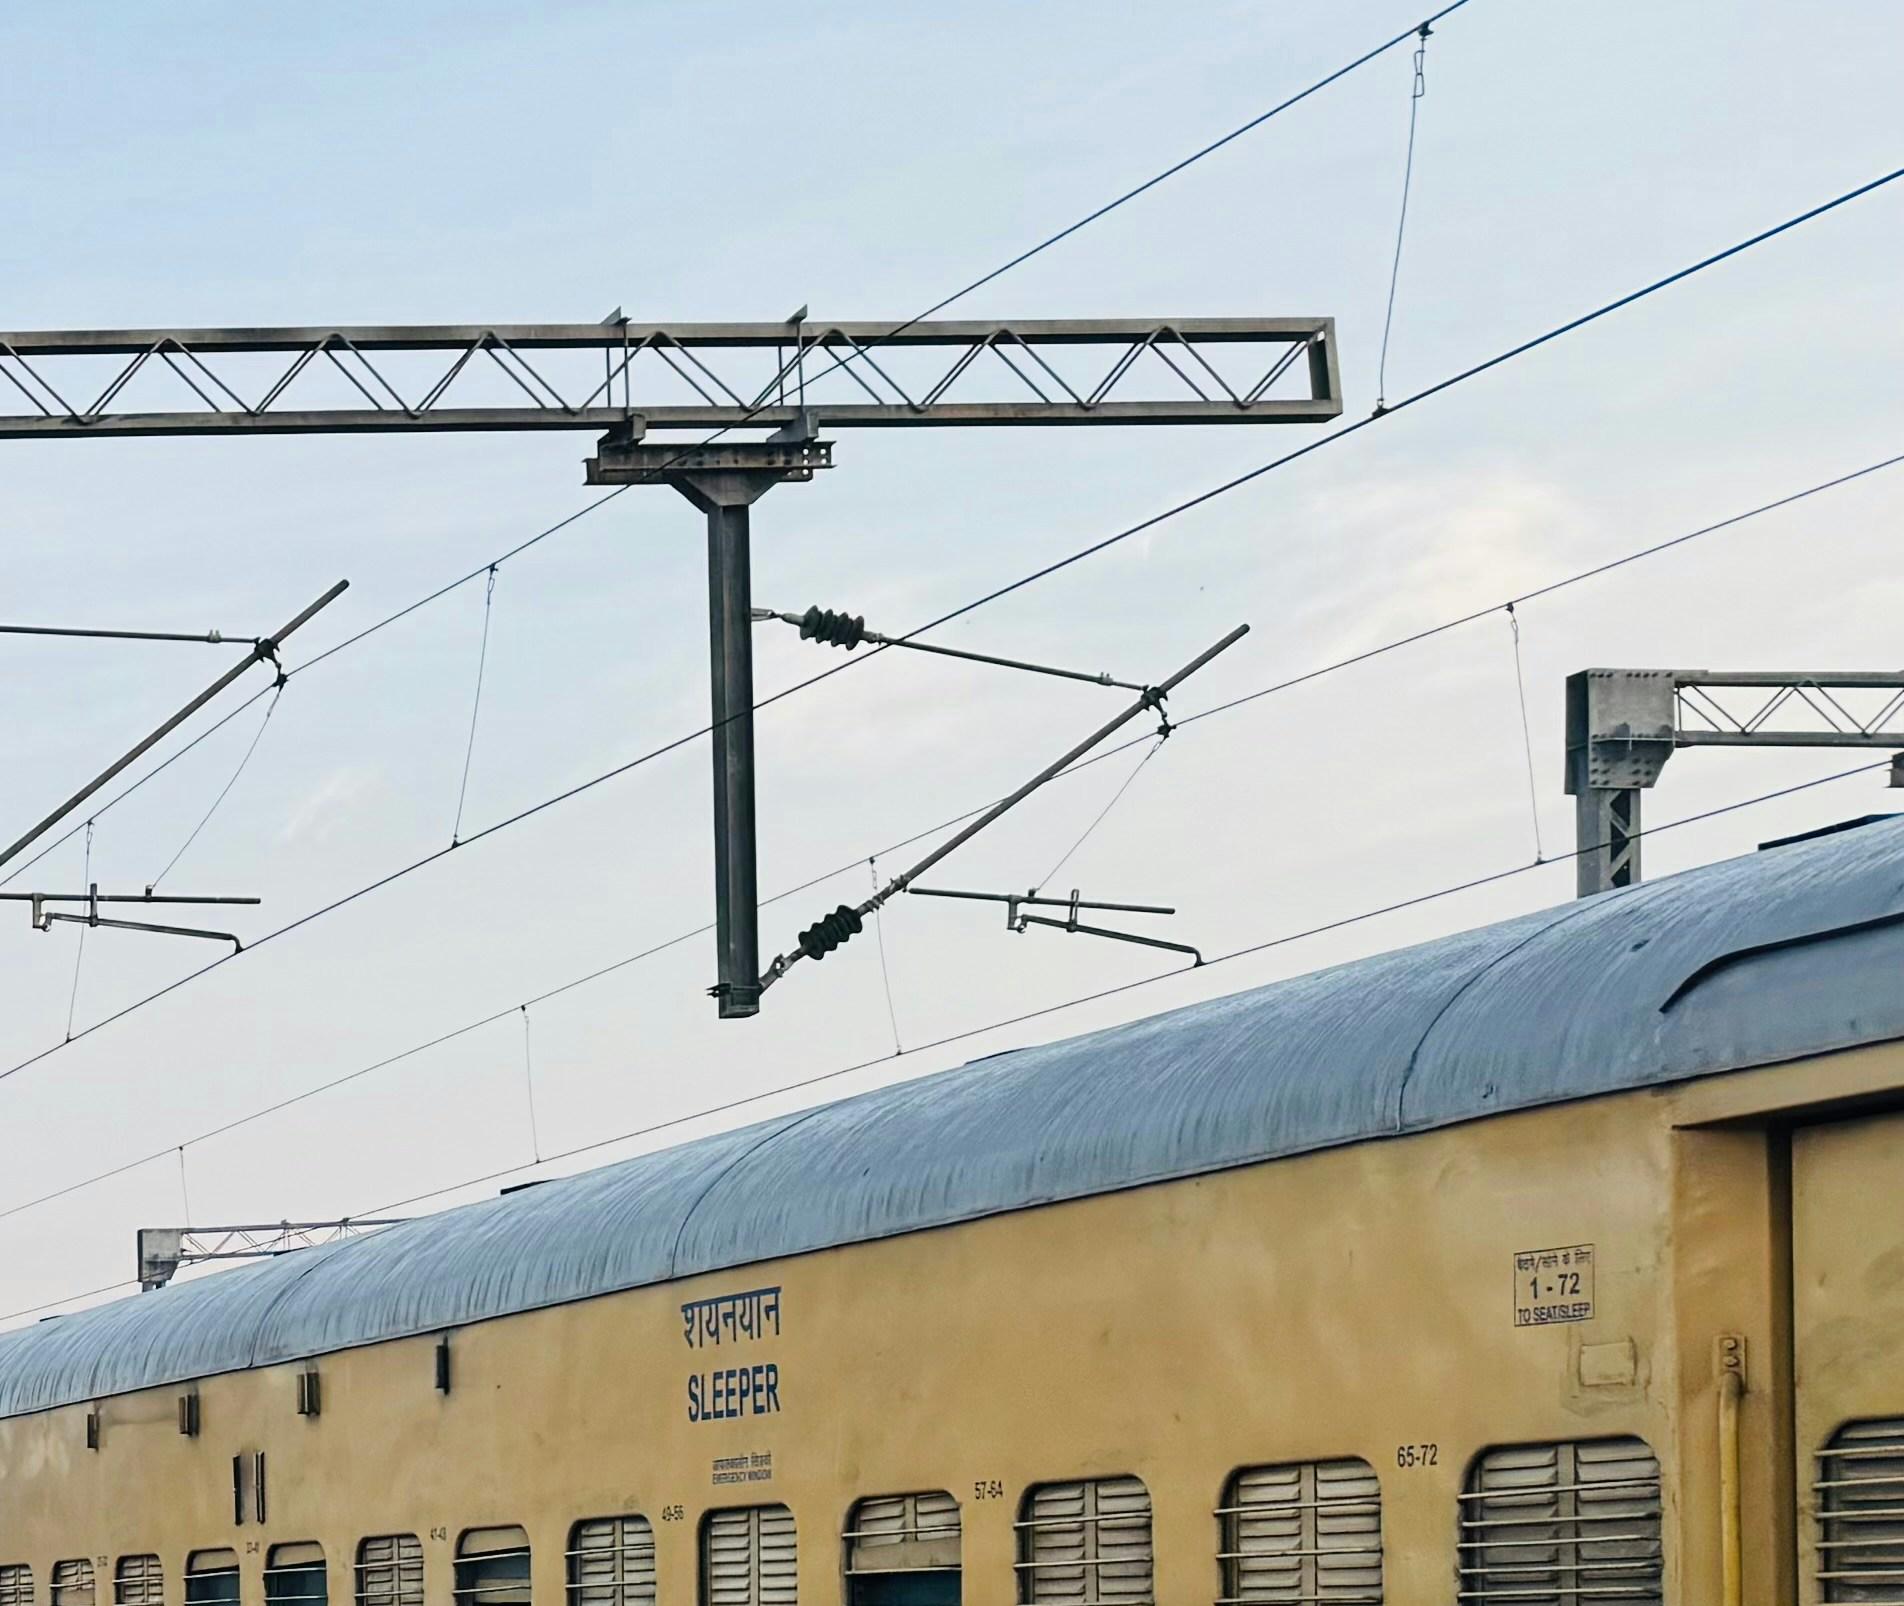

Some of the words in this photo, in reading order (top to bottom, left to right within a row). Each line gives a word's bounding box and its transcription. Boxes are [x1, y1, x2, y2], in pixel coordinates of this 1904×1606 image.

[680, 1286, 782, 1349] शयनयान
[1518, 1308, 1531, 1325] TO
[687, 1363, 781, 1423] SLEEPER
[1397, 1443, 1438, 1468] 65-72
[974, 1480, 1003, 1500] 57-64
